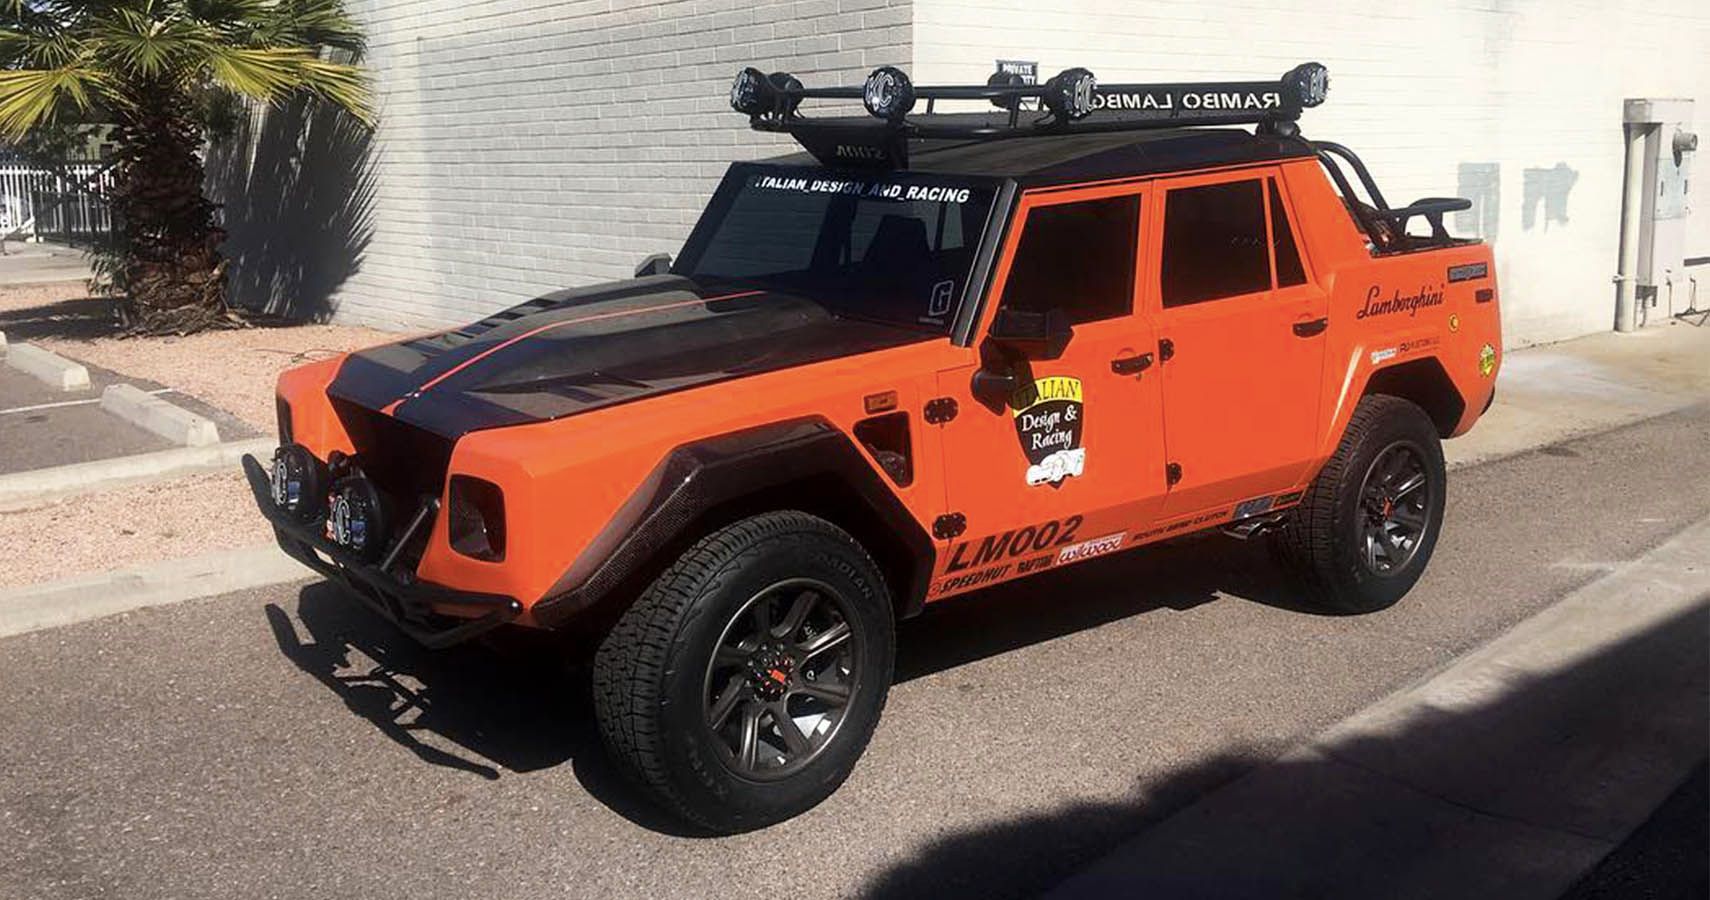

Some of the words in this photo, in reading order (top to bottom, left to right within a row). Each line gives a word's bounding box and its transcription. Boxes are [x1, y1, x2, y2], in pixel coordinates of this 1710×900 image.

[1357, 284, 1445, 319] Lamborghini
[1022, 410, 1061, 433] Design
[1064, 404, 1078, 421] &
[1032, 428, 1072, 450] Racing
[945, 514, 1084, 573] LM002
